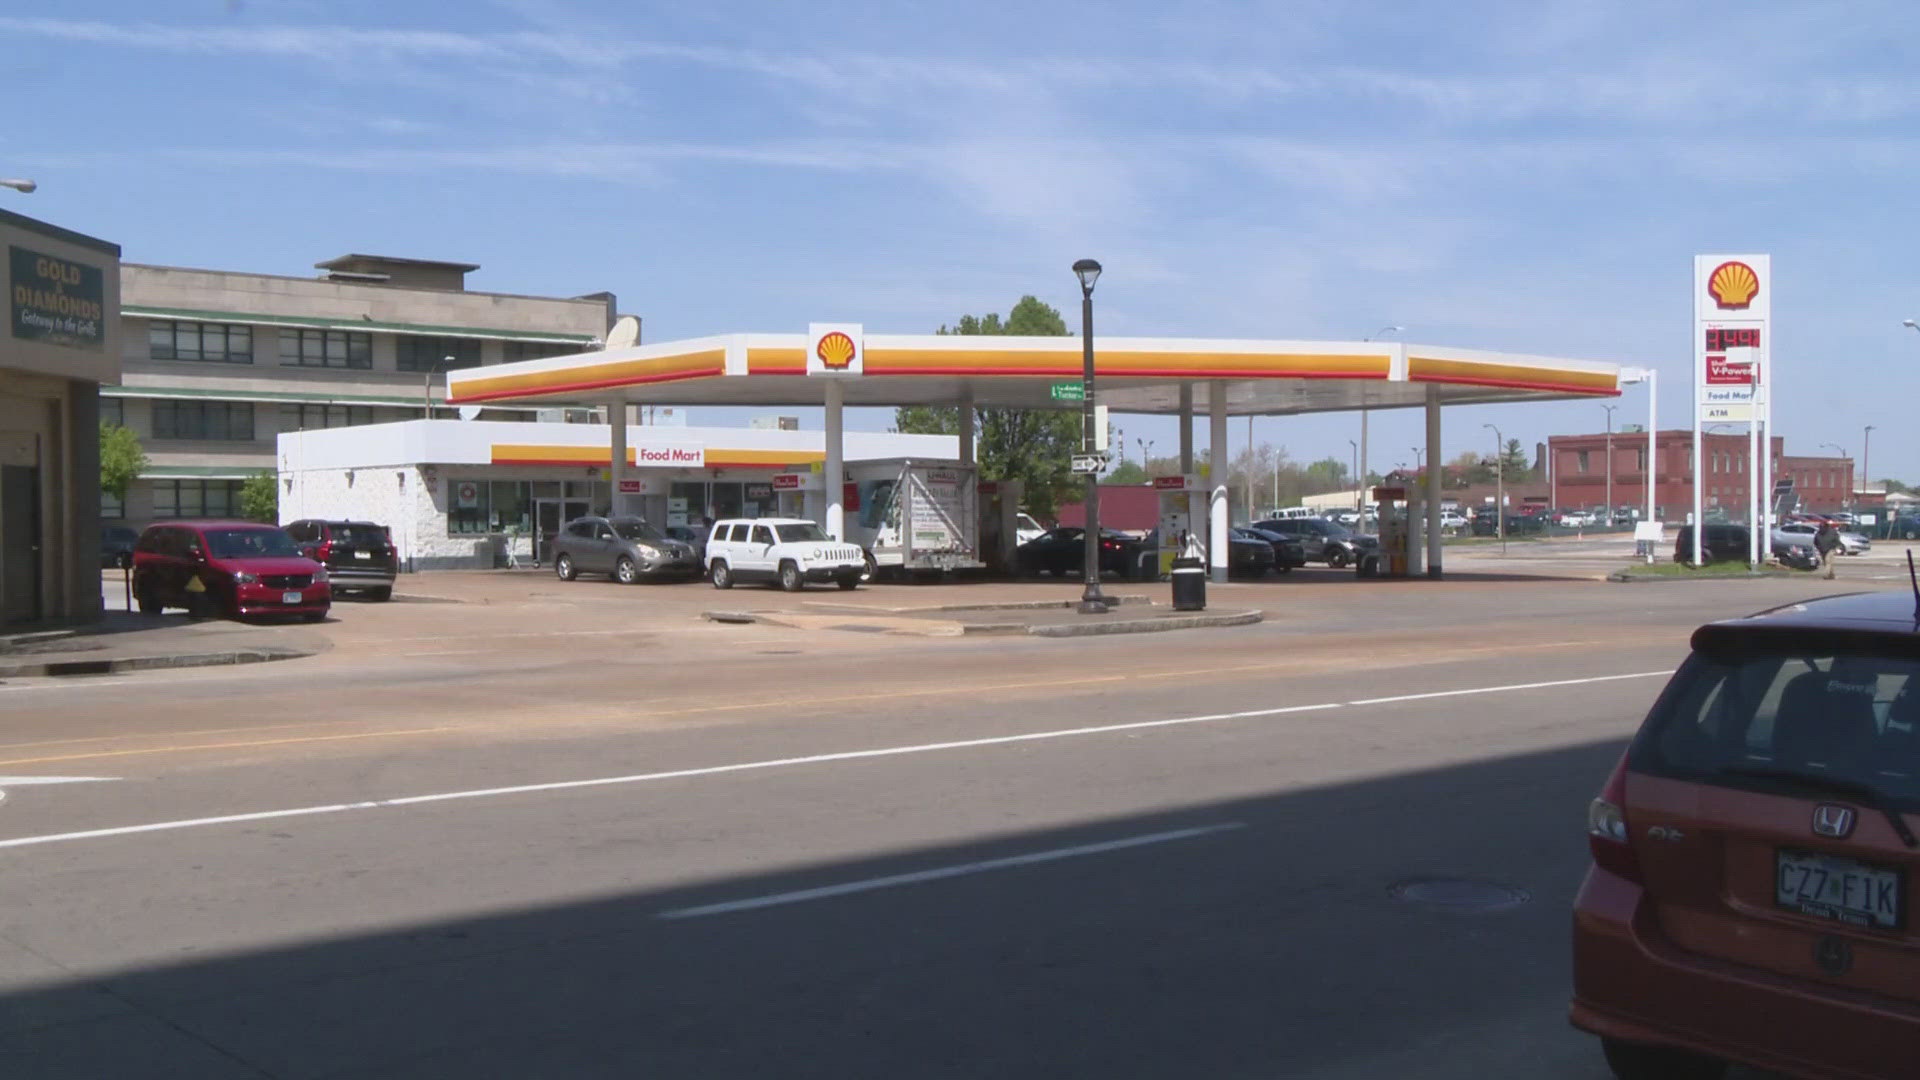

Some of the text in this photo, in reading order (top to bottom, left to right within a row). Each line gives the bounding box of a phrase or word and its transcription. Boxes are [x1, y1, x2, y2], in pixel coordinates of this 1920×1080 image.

[36, 257, 81, 285] GOLD
[15, 285, 101, 320] DIAMONDS
[1708, 391, 1730, 399] Food
[641, 449, 701, 461] Food Mart
[1780, 862, 1829, 900] CZ7
